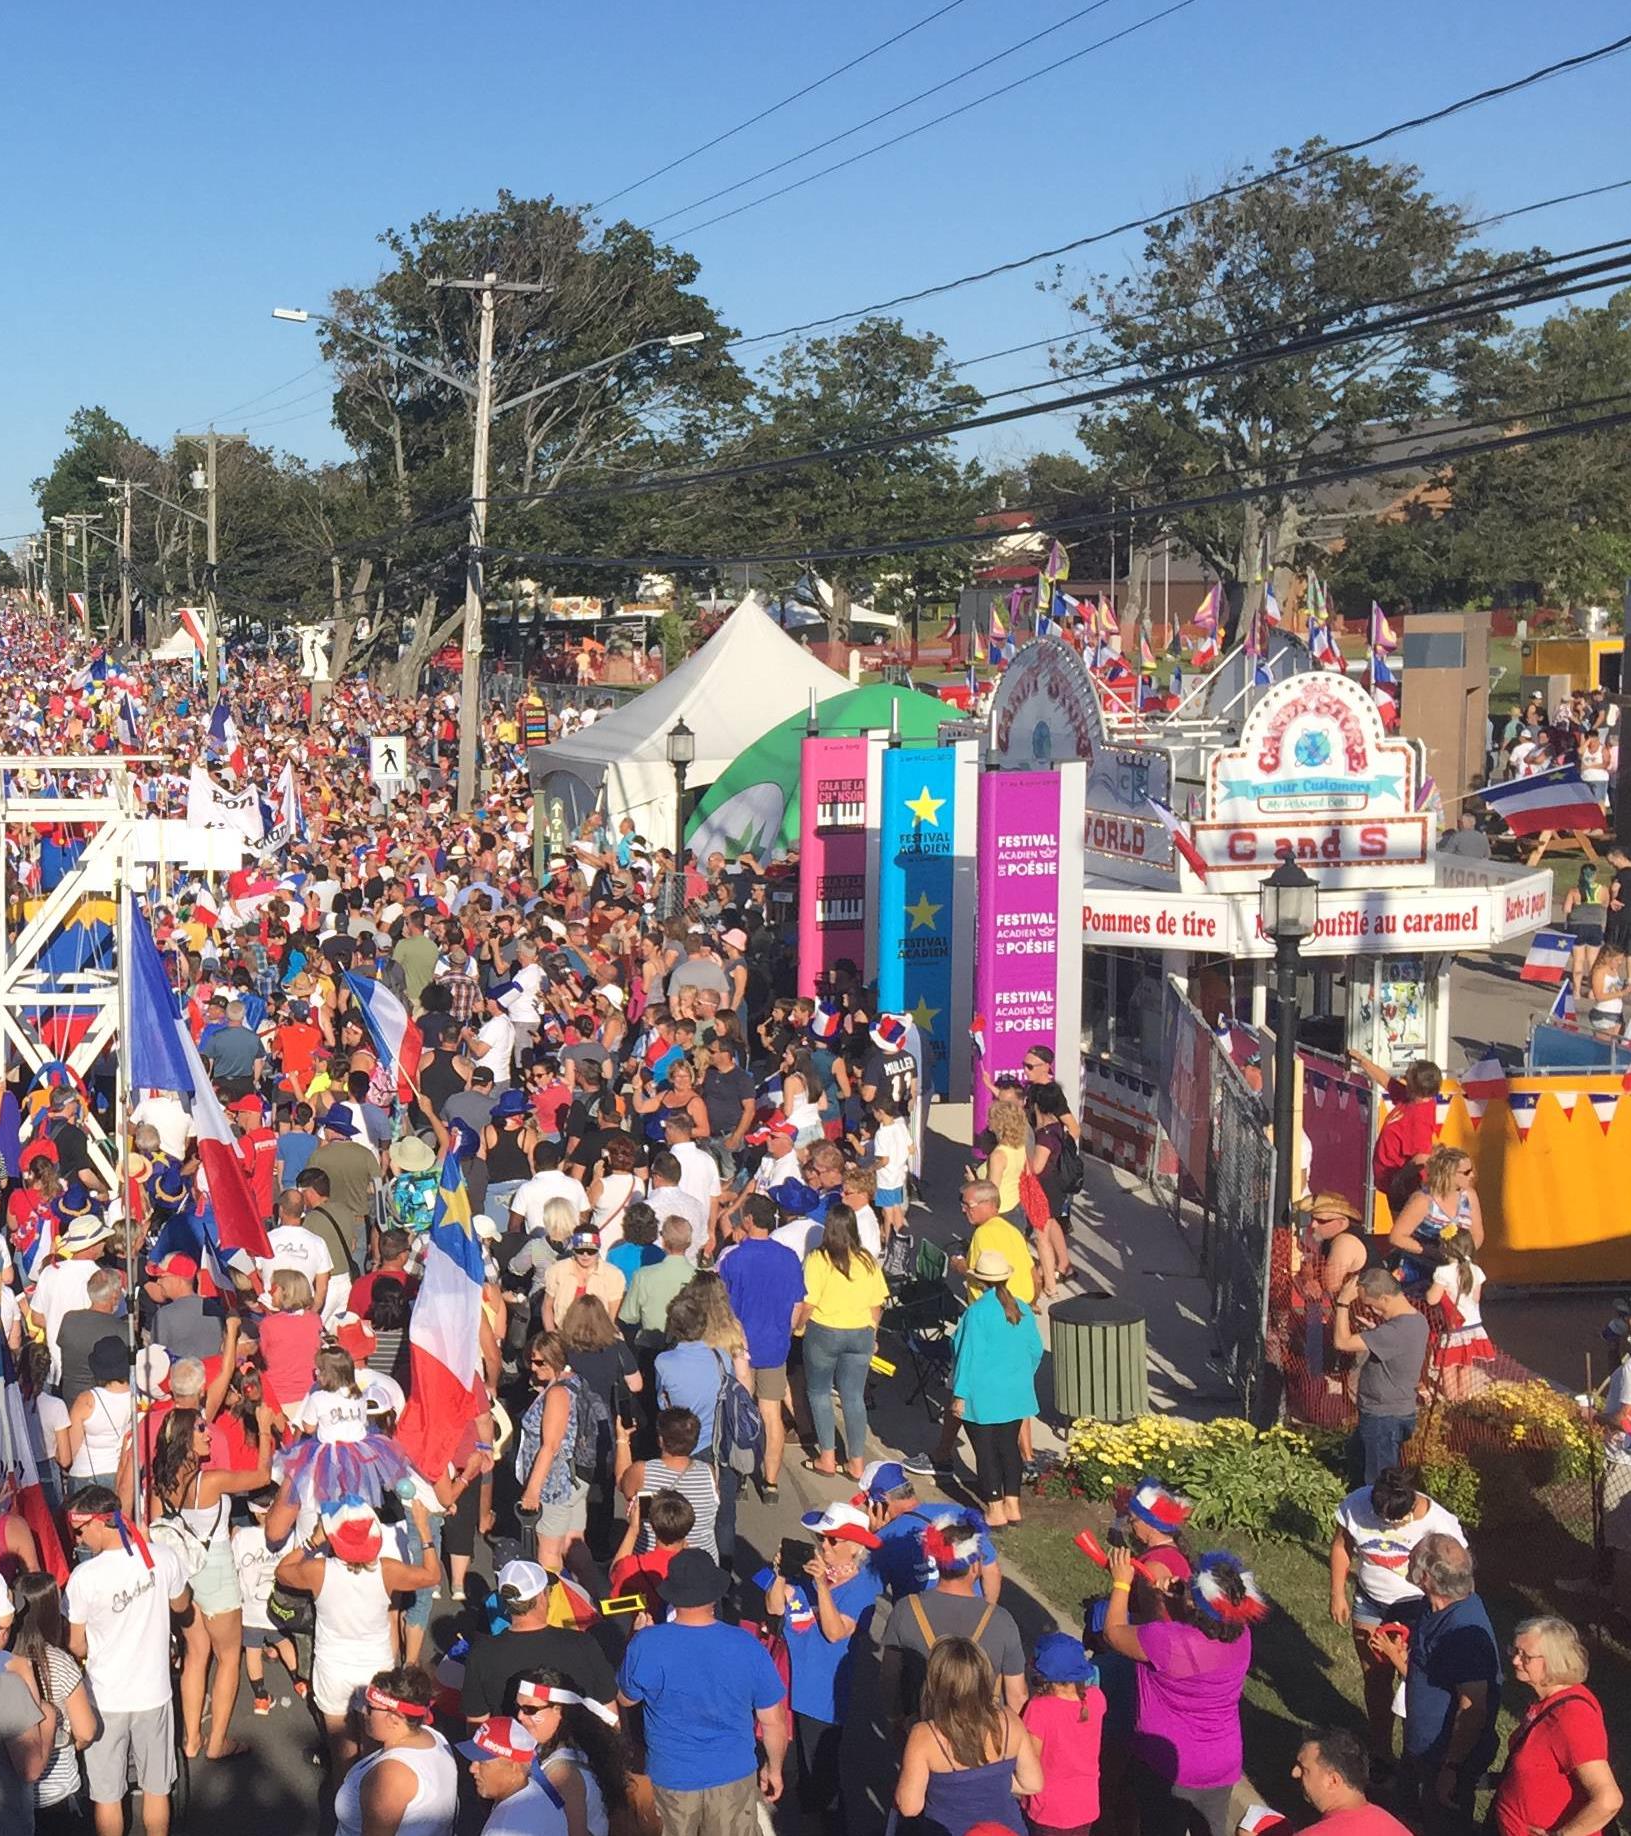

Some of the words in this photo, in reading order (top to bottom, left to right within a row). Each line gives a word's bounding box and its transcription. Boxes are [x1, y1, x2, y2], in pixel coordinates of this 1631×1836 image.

[1257, 697, 1309, 774] CANDY
[1314, 692, 1368, 773] STORE
[818, 781, 840, 791] GALA
[842, 780, 854, 791] DE
[854, 780, 864, 790] LA
[1273, 780, 1298, 794] Our
[1303, 777, 1372, 792] Customers
[900, 831, 951, 844] FESTIVAL
[998, 834, 1057, 849] FESTIVAL
[1228, 832, 1257, 861] C
[1274, 829, 1341, 861] and
[1359, 826, 1388, 857] S
[900, 843, 950, 855] ACADIEN
[998, 850, 1038, 860] ACADIEN
[1007, 860, 1057, 876] POÉSIE
[996, 912, 1055, 927] FESTIVAL
[1082, 905, 1150, 932] Pommes
[1156, 910, 1176, 934] de
[1183, 911, 1216, 937] tire
[1313, 905, 1369, 938] oufflé
[1374, 914, 1397, 934] au
[1403, 905, 1478, 933] caramel
[996, 929, 1036, 939] ACADIEN
[898, 937, 948, 949] FESTIVAL
[1006, 938, 1055, 954] POÉSIE
[995, 991, 1054, 1005] FESTIVAL
[995, 1006, 1035, 1016] ACADIEN
[1005, 1016, 1054, 1032] POÉSIE
